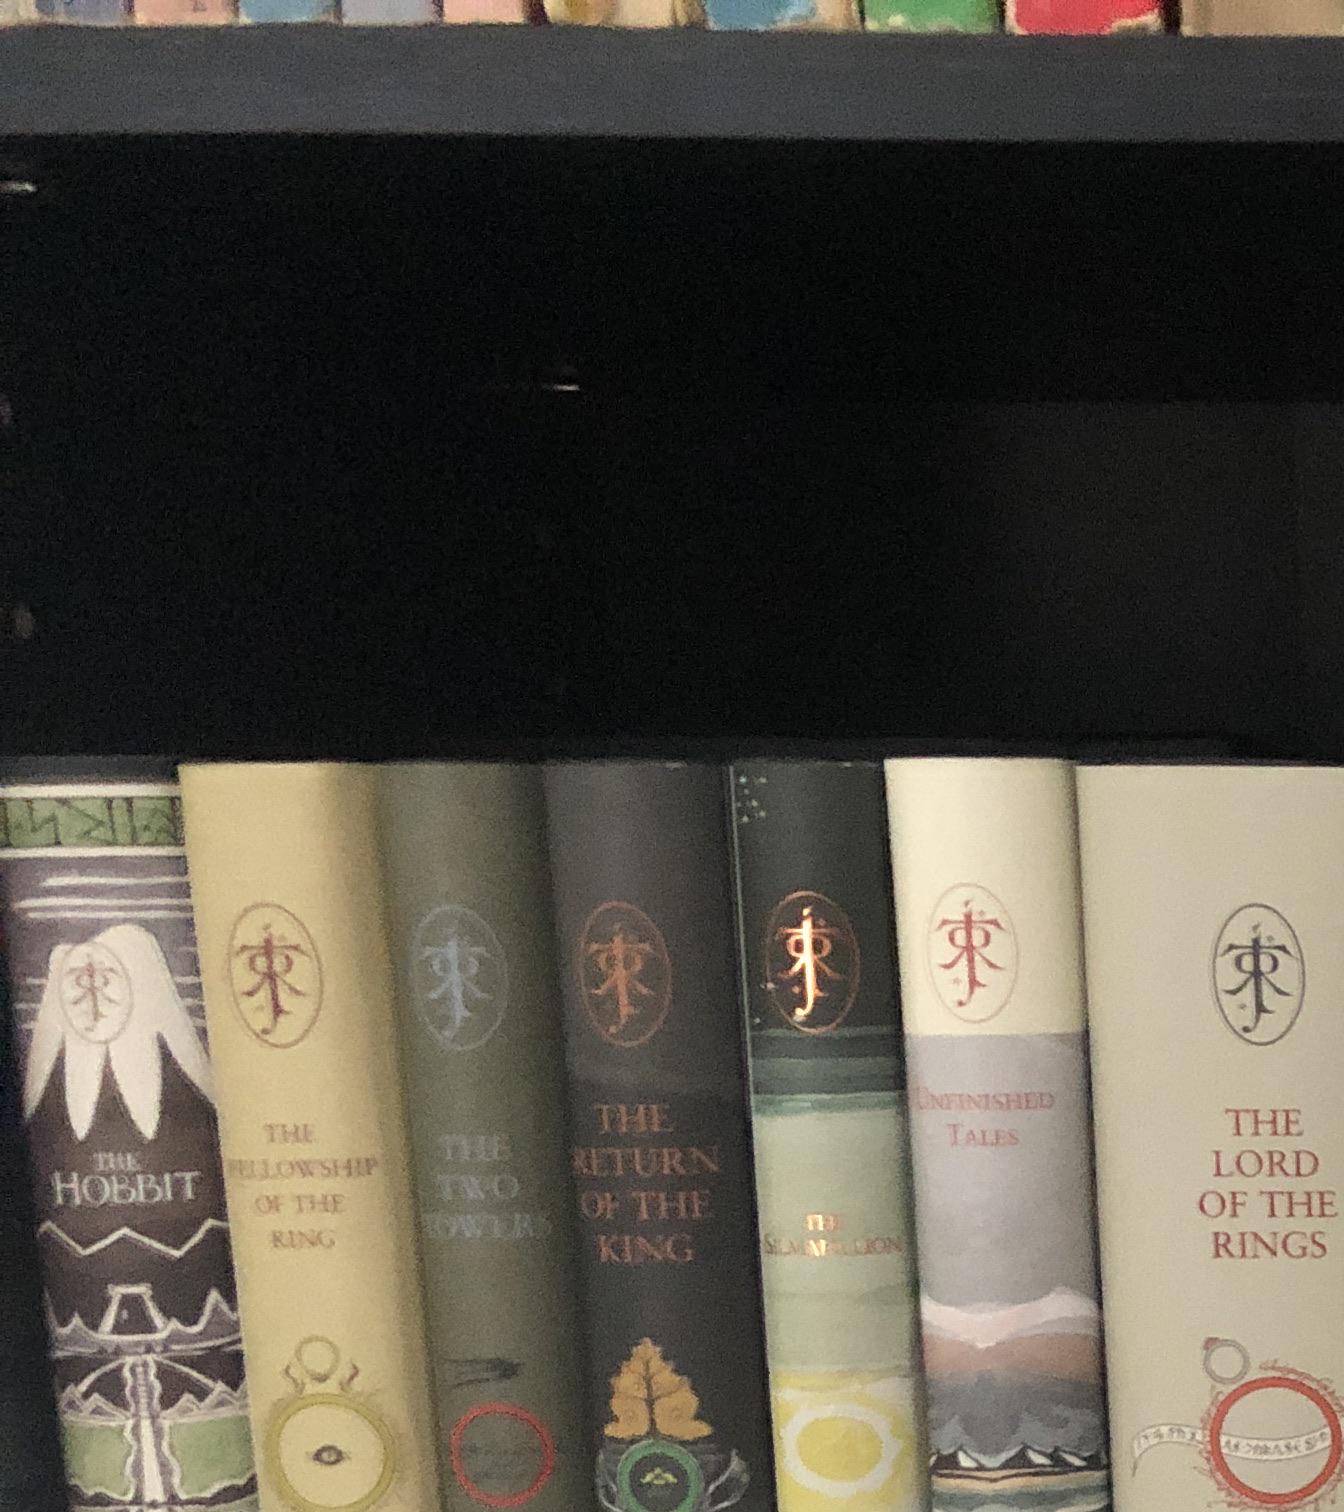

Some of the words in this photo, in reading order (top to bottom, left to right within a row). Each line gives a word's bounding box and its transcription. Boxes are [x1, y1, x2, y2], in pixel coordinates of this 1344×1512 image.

[914, 1086, 1058, 1112] UNFINISHED
[263, 1122, 316, 1145] THE
[594, 1102, 673, 1135] THE
[1225, 1107, 1304, 1138] THE
[946, 1121, 1022, 1149] TALES
[228, 1156, 381, 1179] FELLOWSHIP
[572, 1144, 721, 1178] RETURN
[1212, 1149, 1320, 1179] LORD
[52, 1169, 202, 1206] HOBBIT
[255, 1192, 283, 1215] OF
[294, 1190, 347, 1214] THE
[581, 1190, 620, 1221] OF
[633, 1189, 711, 1220] THE
[1198, 1189, 1248, 1219] OF
[1261, 1190, 1339, 1219] THE
[271, 1227, 337, 1251] RING
[595, 1232, 697, 1265] KING
[1211, 1230, 1329, 1260] RINGS
